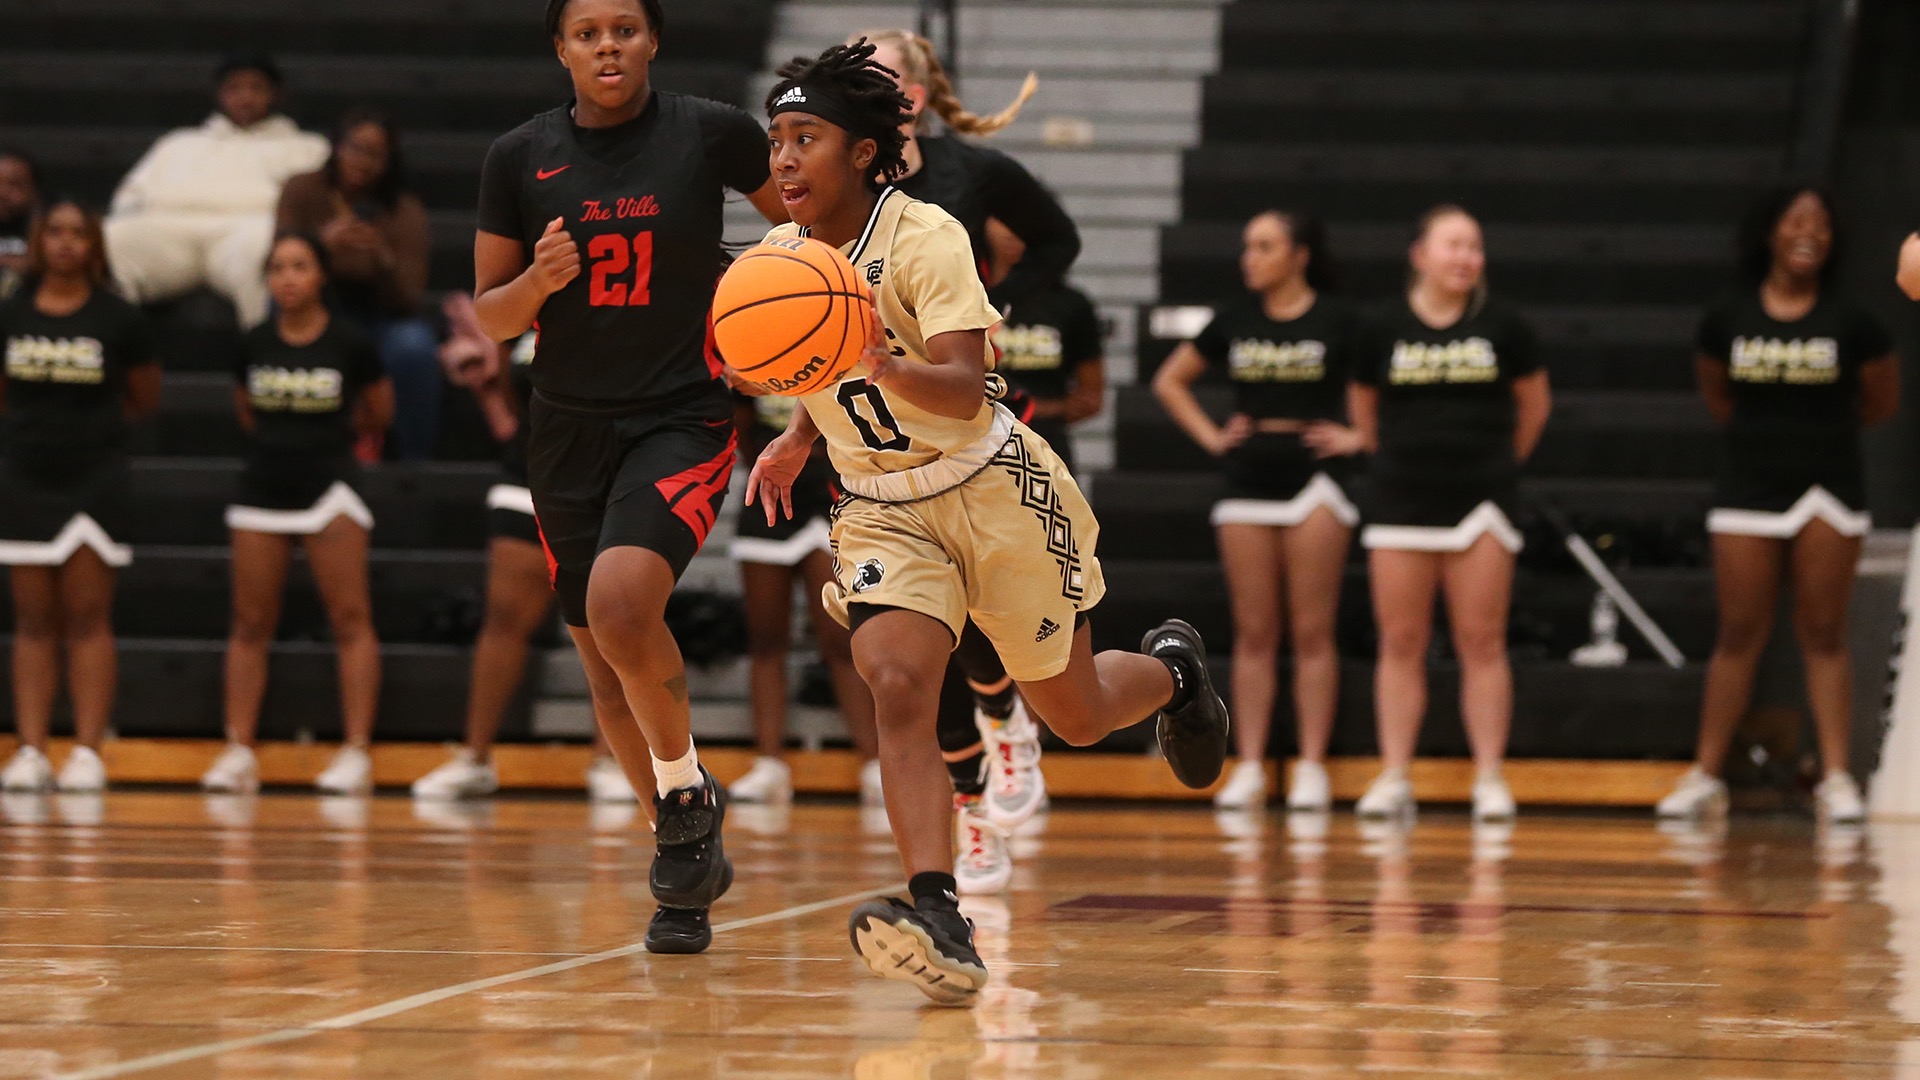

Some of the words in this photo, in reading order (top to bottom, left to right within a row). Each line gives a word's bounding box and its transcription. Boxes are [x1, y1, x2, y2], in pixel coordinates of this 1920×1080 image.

[579, 200, 612, 222] The
[616, 194, 661, 219] Ville
[587, 230, 653, 307] 21
[755, 355, 828, 392] ilson
[834, 376, 911, 452] 0
[1035, 623, 1061, 643] adidas
